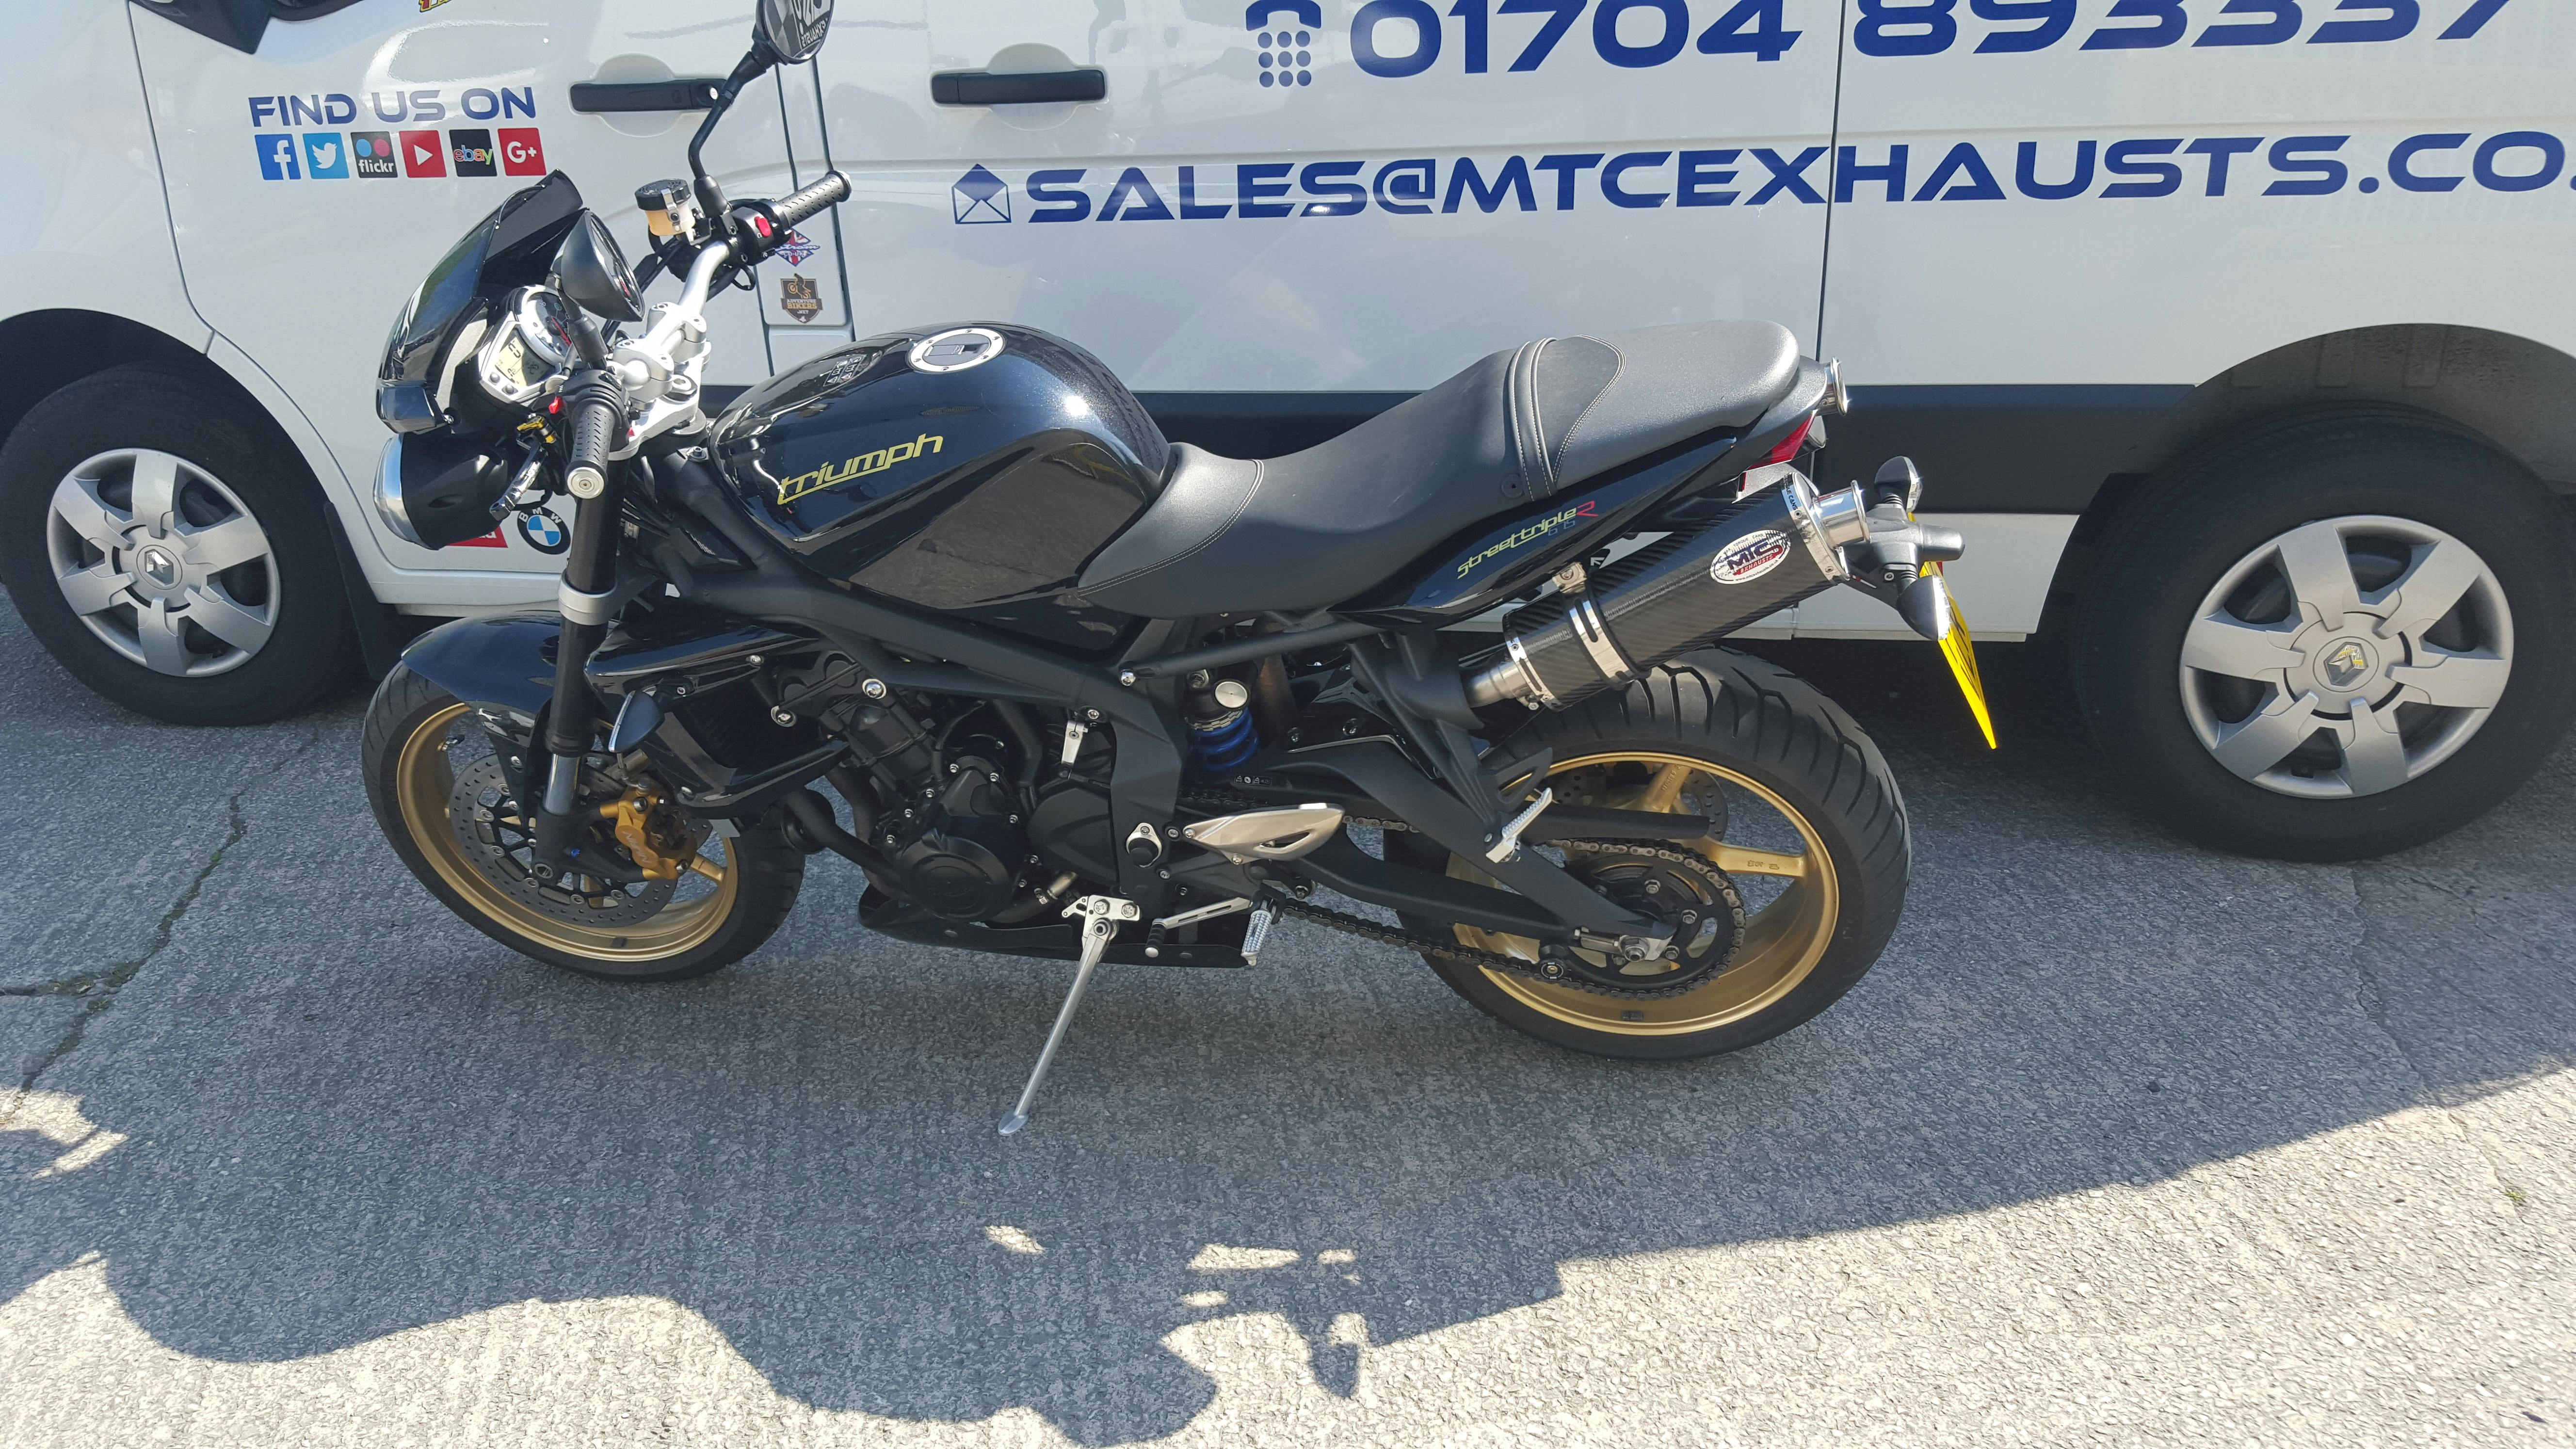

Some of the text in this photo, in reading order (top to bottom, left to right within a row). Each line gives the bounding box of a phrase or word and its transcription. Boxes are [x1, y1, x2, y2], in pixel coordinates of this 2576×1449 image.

[1351, 0, 1803, 78] 01704
[249, 87, 536, 127] FIND US ON
[453, 145, 493, 165] ebay
[358, 159, 394, 173] flickr
[778, 434, 943, 505] triumph
[1788, 495, 1798, 510] CANS
[519, 507, 562, 524] BMW
[1733, 537, 1748, 547] TORQUE
[1725, 539, 1780, 570] MTC
[1740, 554, 1773, 574] EXHAUSTS
